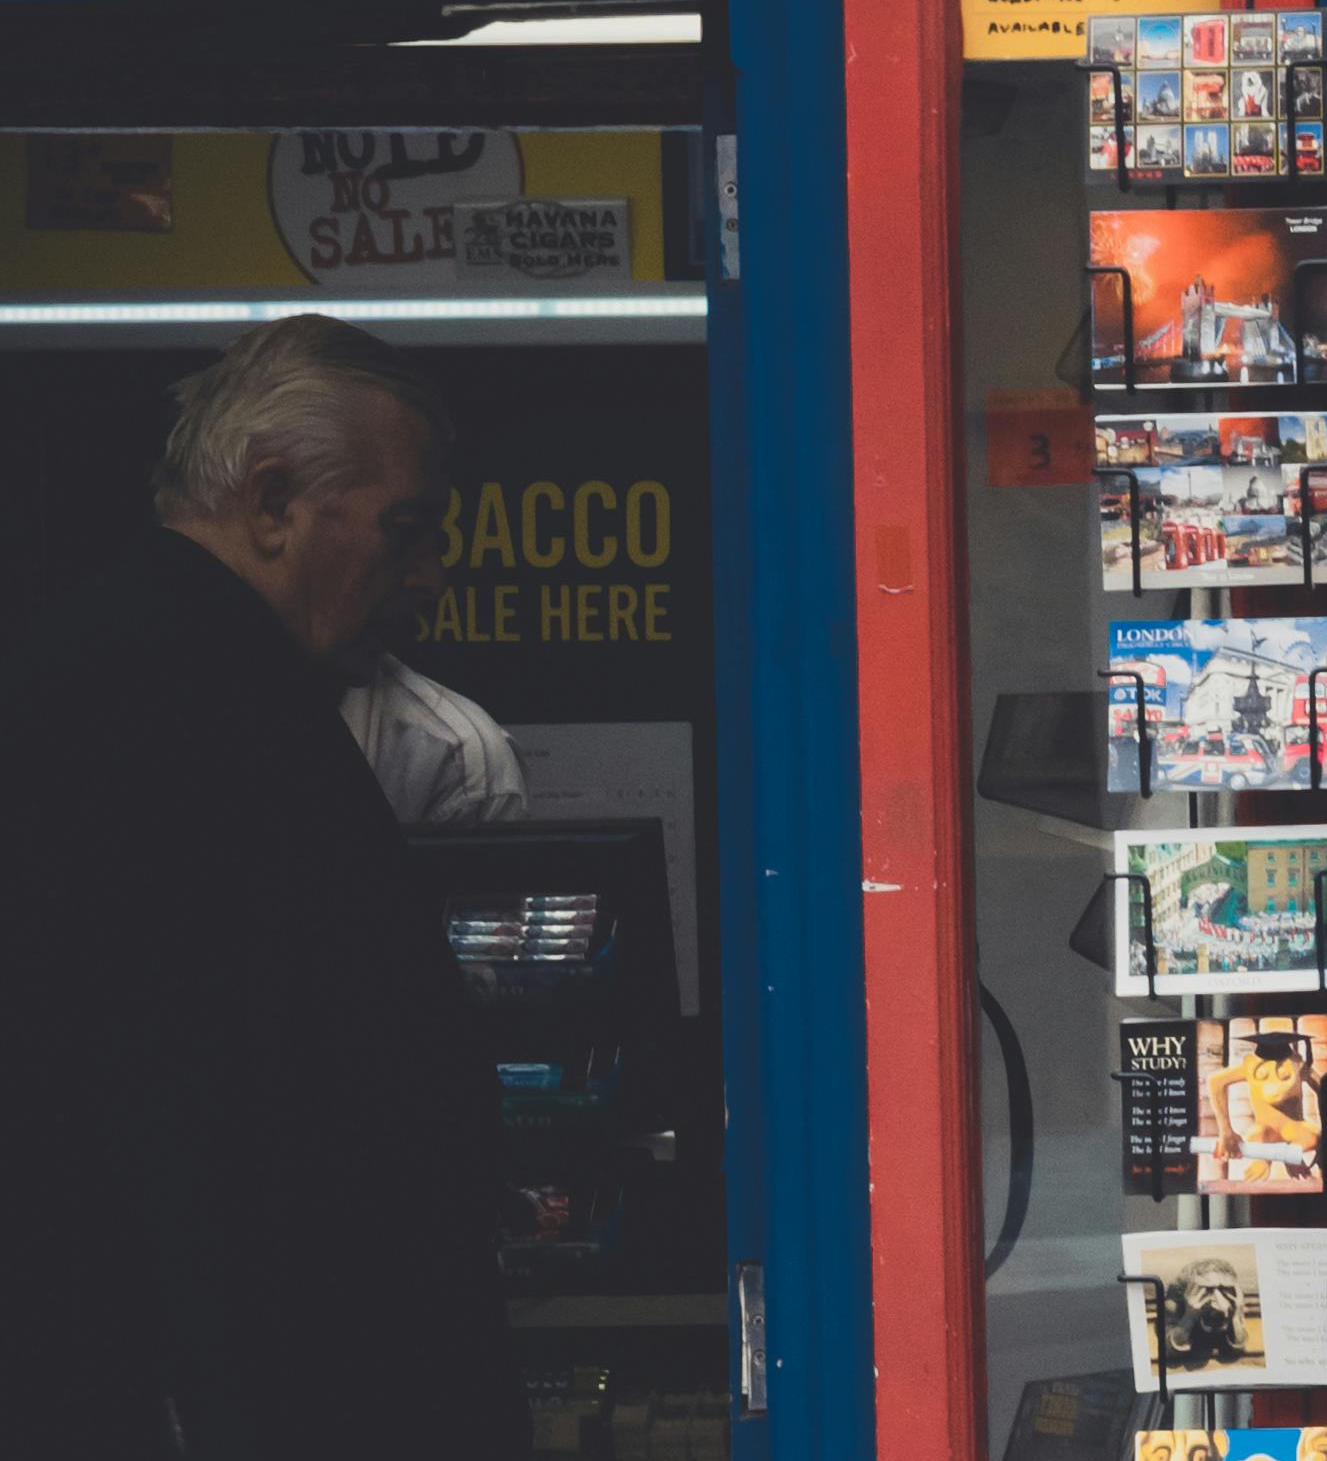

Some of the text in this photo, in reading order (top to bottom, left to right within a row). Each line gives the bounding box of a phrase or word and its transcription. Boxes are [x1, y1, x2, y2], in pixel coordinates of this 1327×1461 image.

[987, 21, 1086, 37] AVAILABLE
[328, 170, 390, 213] NO
[506, 210, 618, 228] HAVANA
[309, 206, 456, 268] SALE
[509, 231, 616, 249] CIGARS
[440, 479, 673, 570] BACCO
[539, 583, 673, 642] HERE
[1128, 1036, 1187, 1057] WHY
[1131, 1056, 1188, 1071] STUDY?
